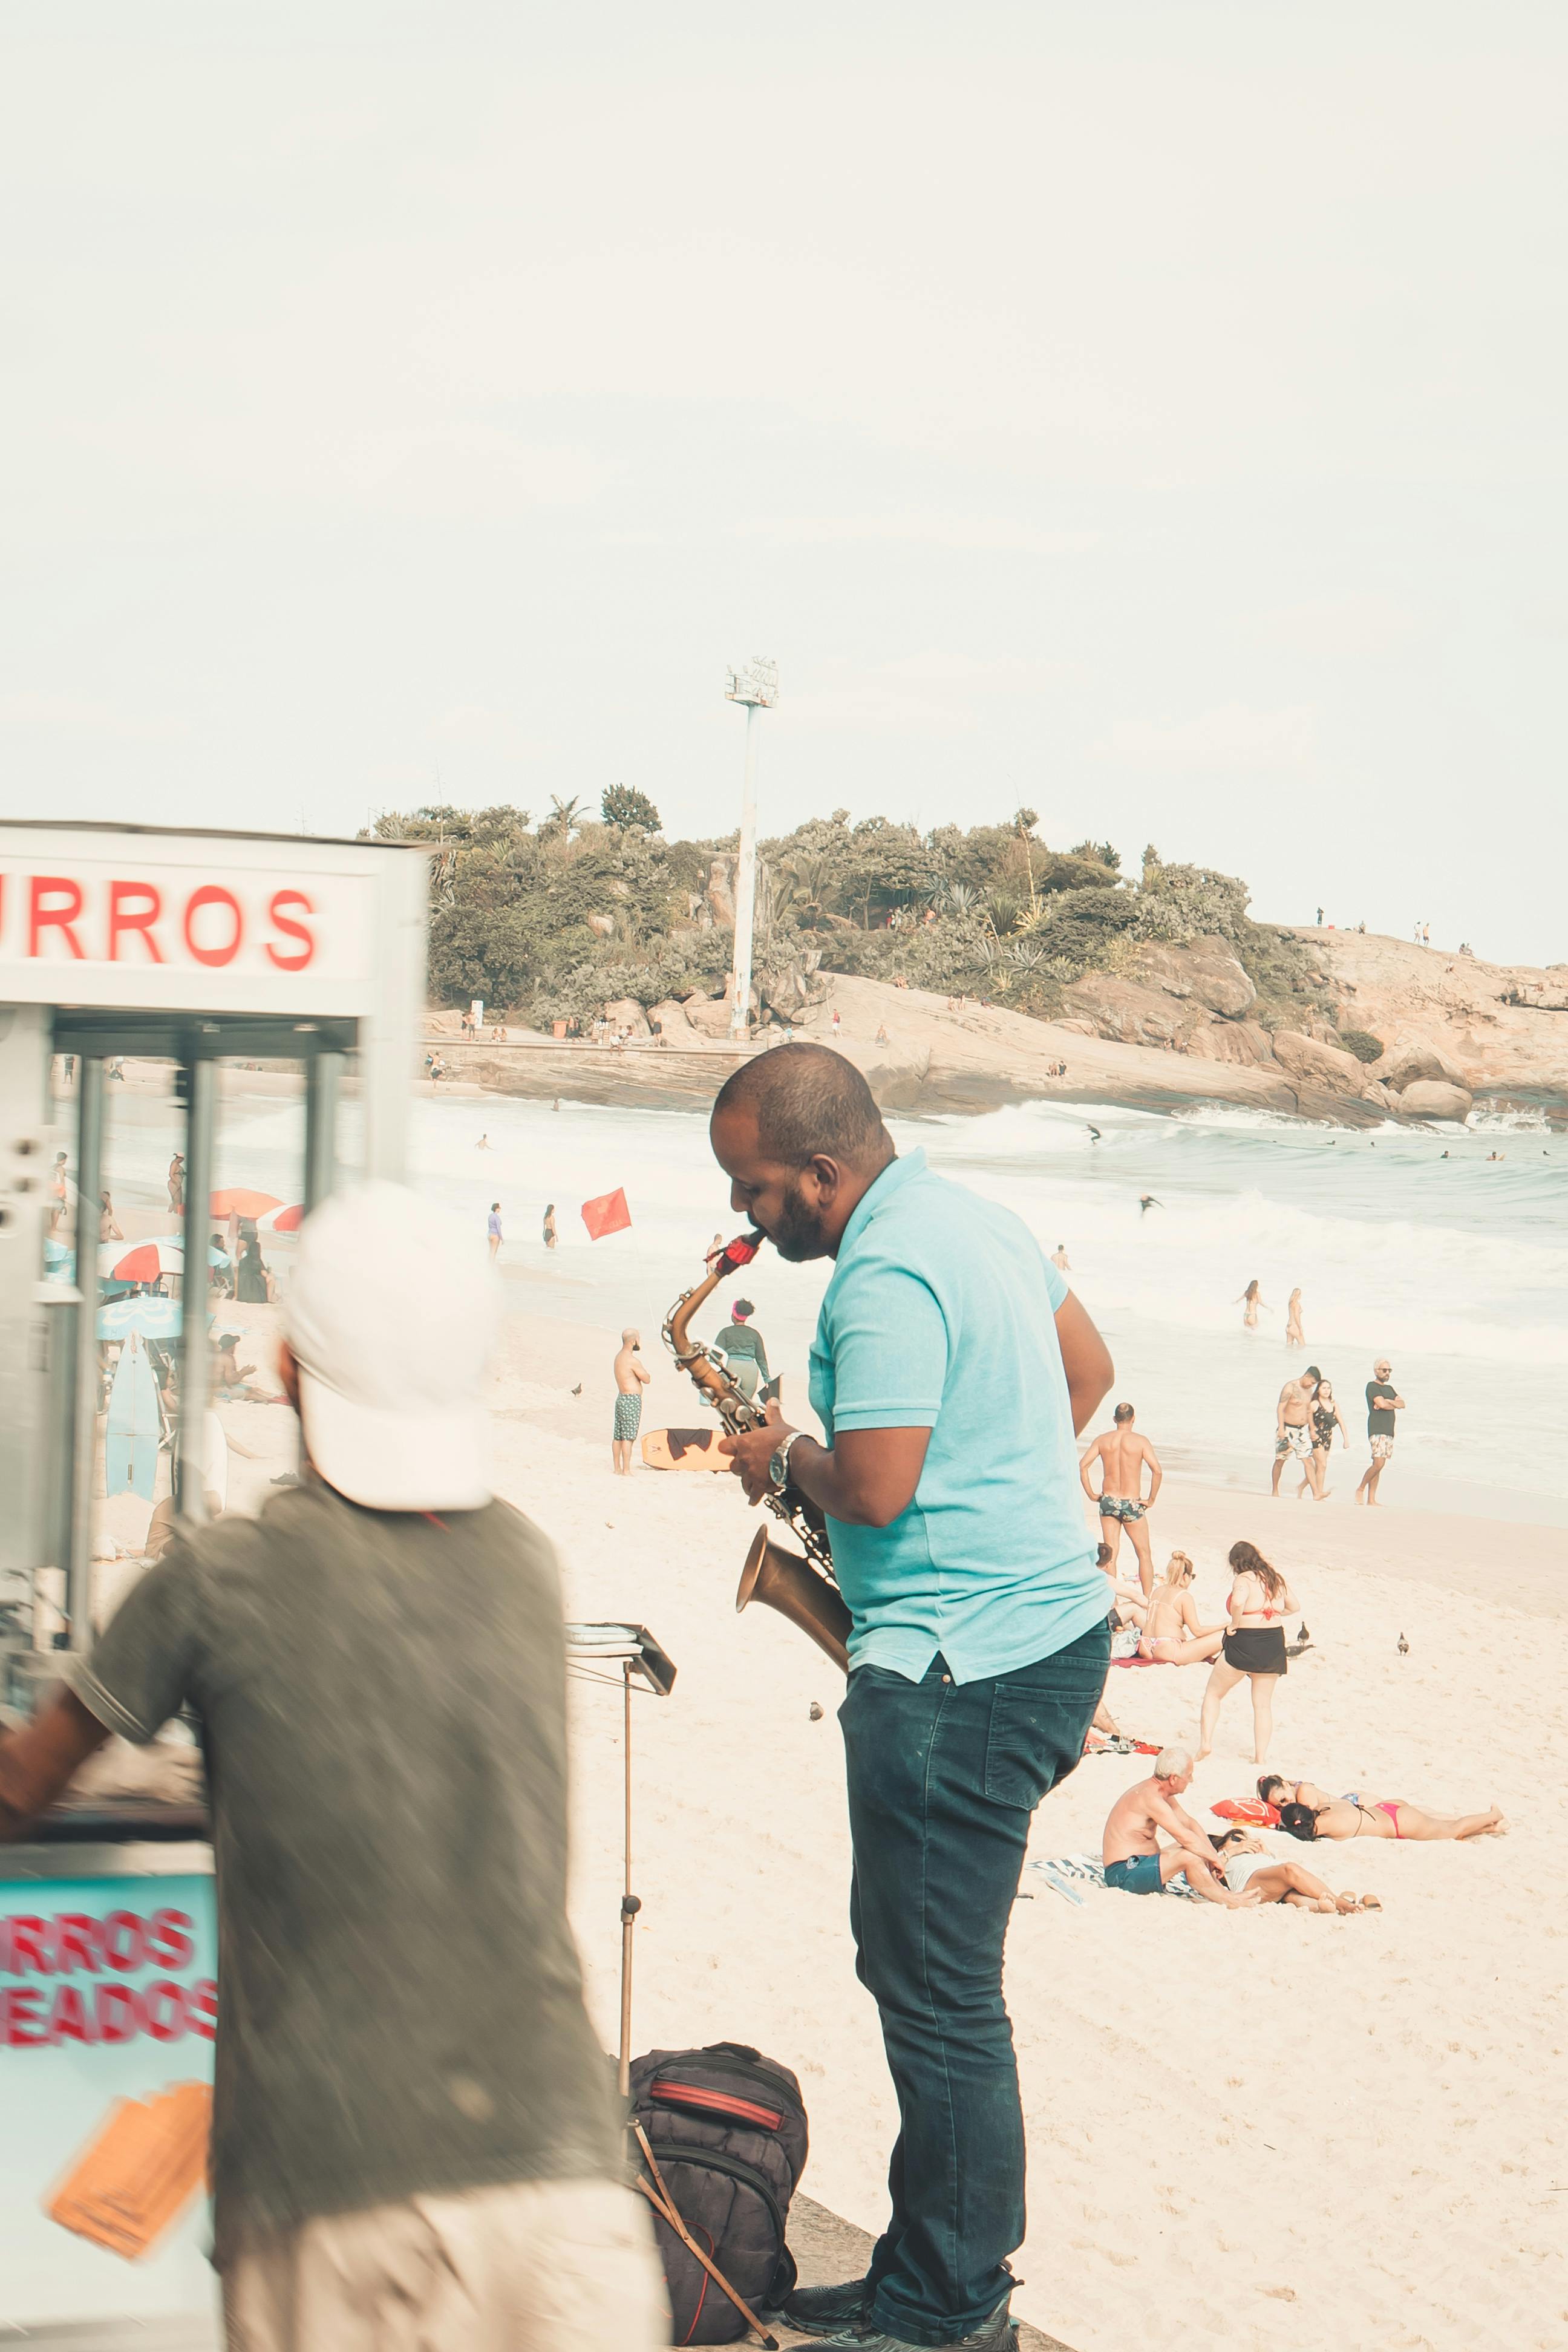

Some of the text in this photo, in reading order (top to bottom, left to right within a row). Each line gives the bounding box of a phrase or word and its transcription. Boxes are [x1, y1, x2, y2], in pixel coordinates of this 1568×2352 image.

[0, 874, 316, 971] RROS
[0, 1907, 193, 1977] RROS
[0, 1979, 217, 2047] EADOS
